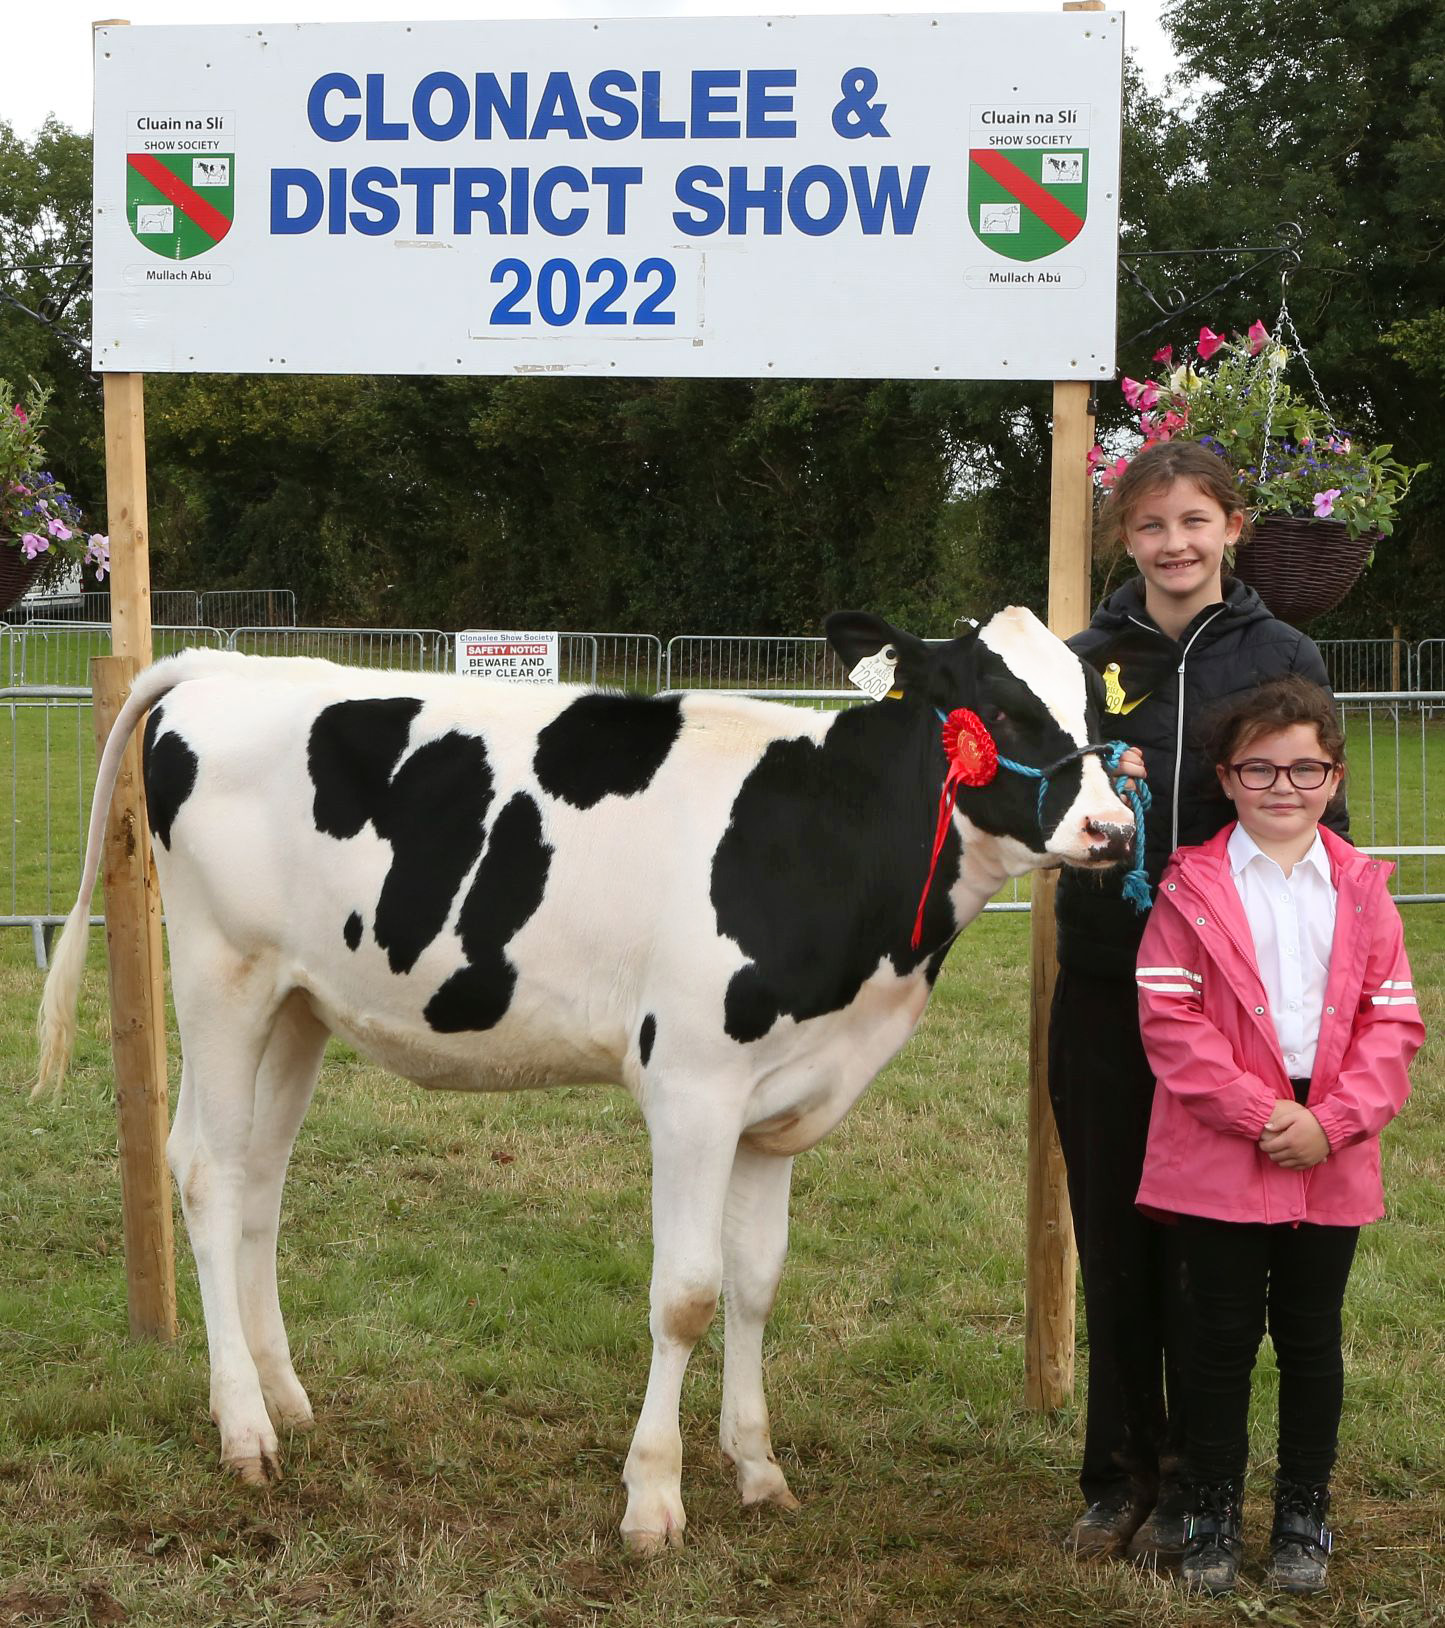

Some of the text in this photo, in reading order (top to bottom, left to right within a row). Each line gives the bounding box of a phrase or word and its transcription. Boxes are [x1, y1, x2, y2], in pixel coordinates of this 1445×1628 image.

[307, 67, 891, 142] CLONASLEE &
[981, 109, 1077, 124] Cluain na Slí
[137, 116, 224, 130] Cluain na Slí
[144, 140, 220, 150] SHOW SOCIETY
[989, 135, 1072, 145] SHOW SOCIETY
[270, 164, 931, 236] DISTRICT SHOW
[146, 270, 212, 280] Mullach Abú
[989, 272, 1061, 283] Mullach Abú
[489, 257, 677, 326] 2022
[459, 634, 499, 642] Clonaslee
[468, 645, 547, 655] SAFETY NOTICE
[469, 658, 544, 667] BEWARE AND
[496, 668, 534, 677] CLEAR
[538, 668, 553, 677] OF
[851, 665, 888, 697] 72609
